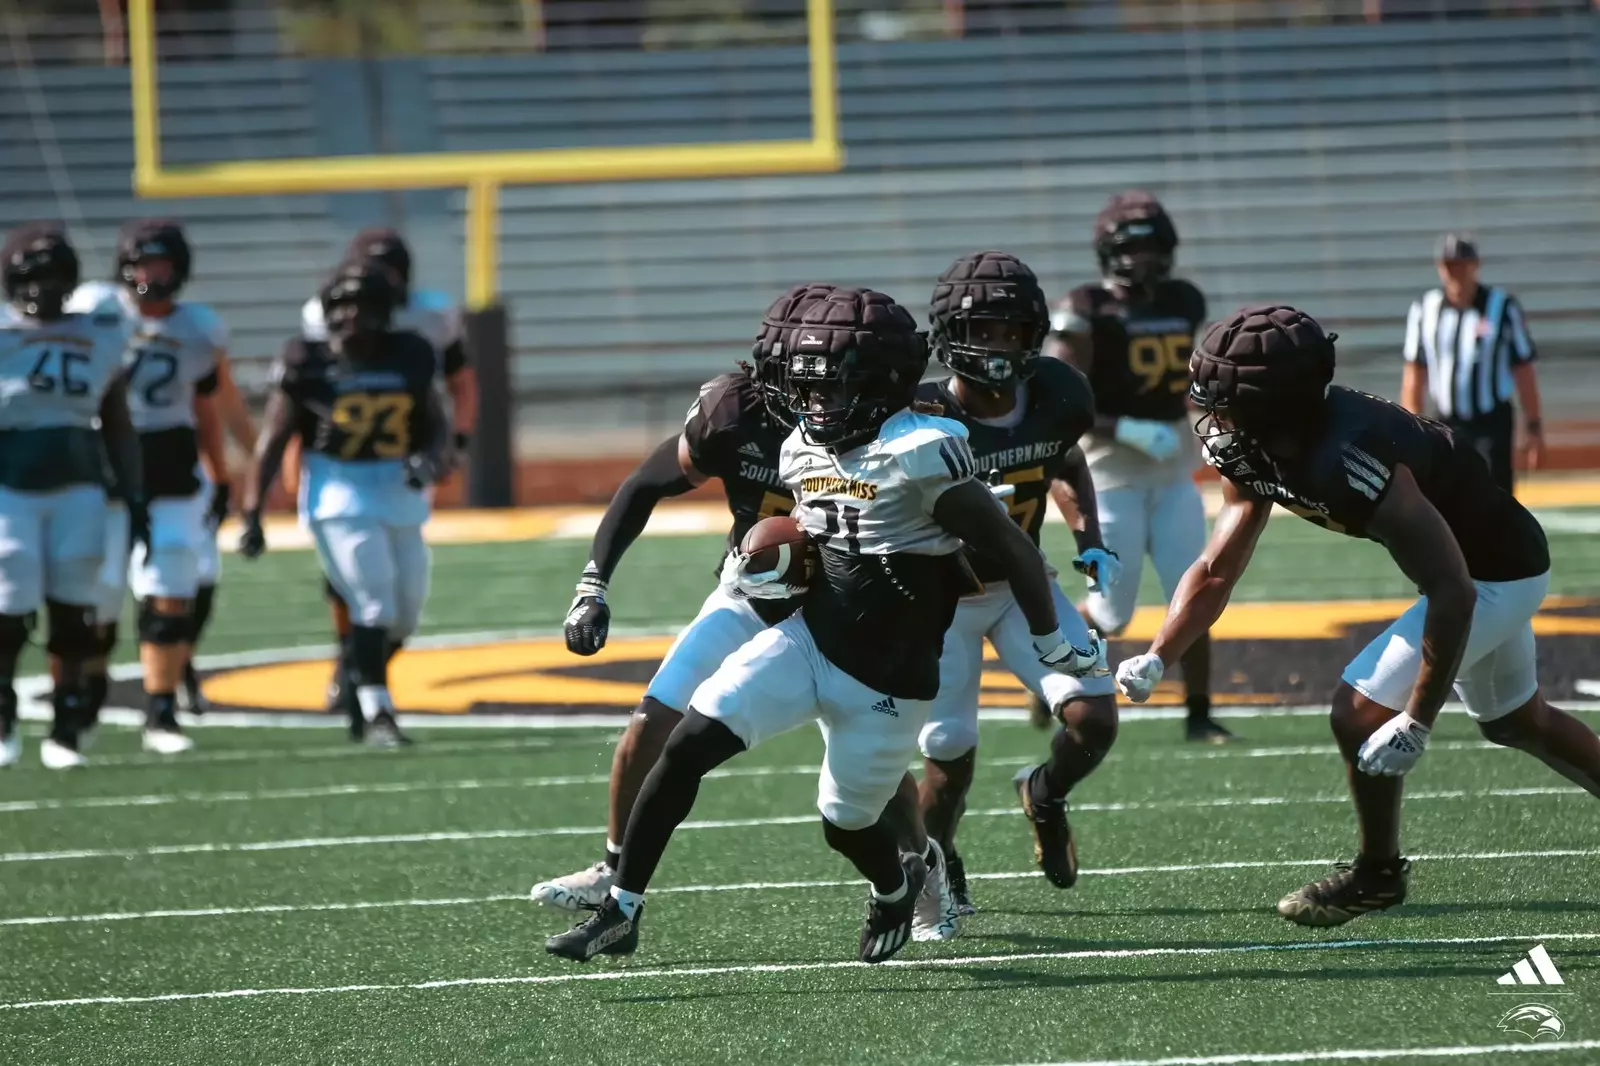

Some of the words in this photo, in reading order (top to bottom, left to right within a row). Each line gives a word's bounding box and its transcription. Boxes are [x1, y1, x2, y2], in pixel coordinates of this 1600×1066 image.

[1129, 334, 1191, 392] 95
[332, 393, 415, 458] 93
[1033, 441, 1062, 459] MISS
[802, 476, 847, 495] SOUTHERN
[848, 479, 878, 501] MISS
[871, 704, 899, 718] adidas
[1395, 727, 1416, 753] adidas
